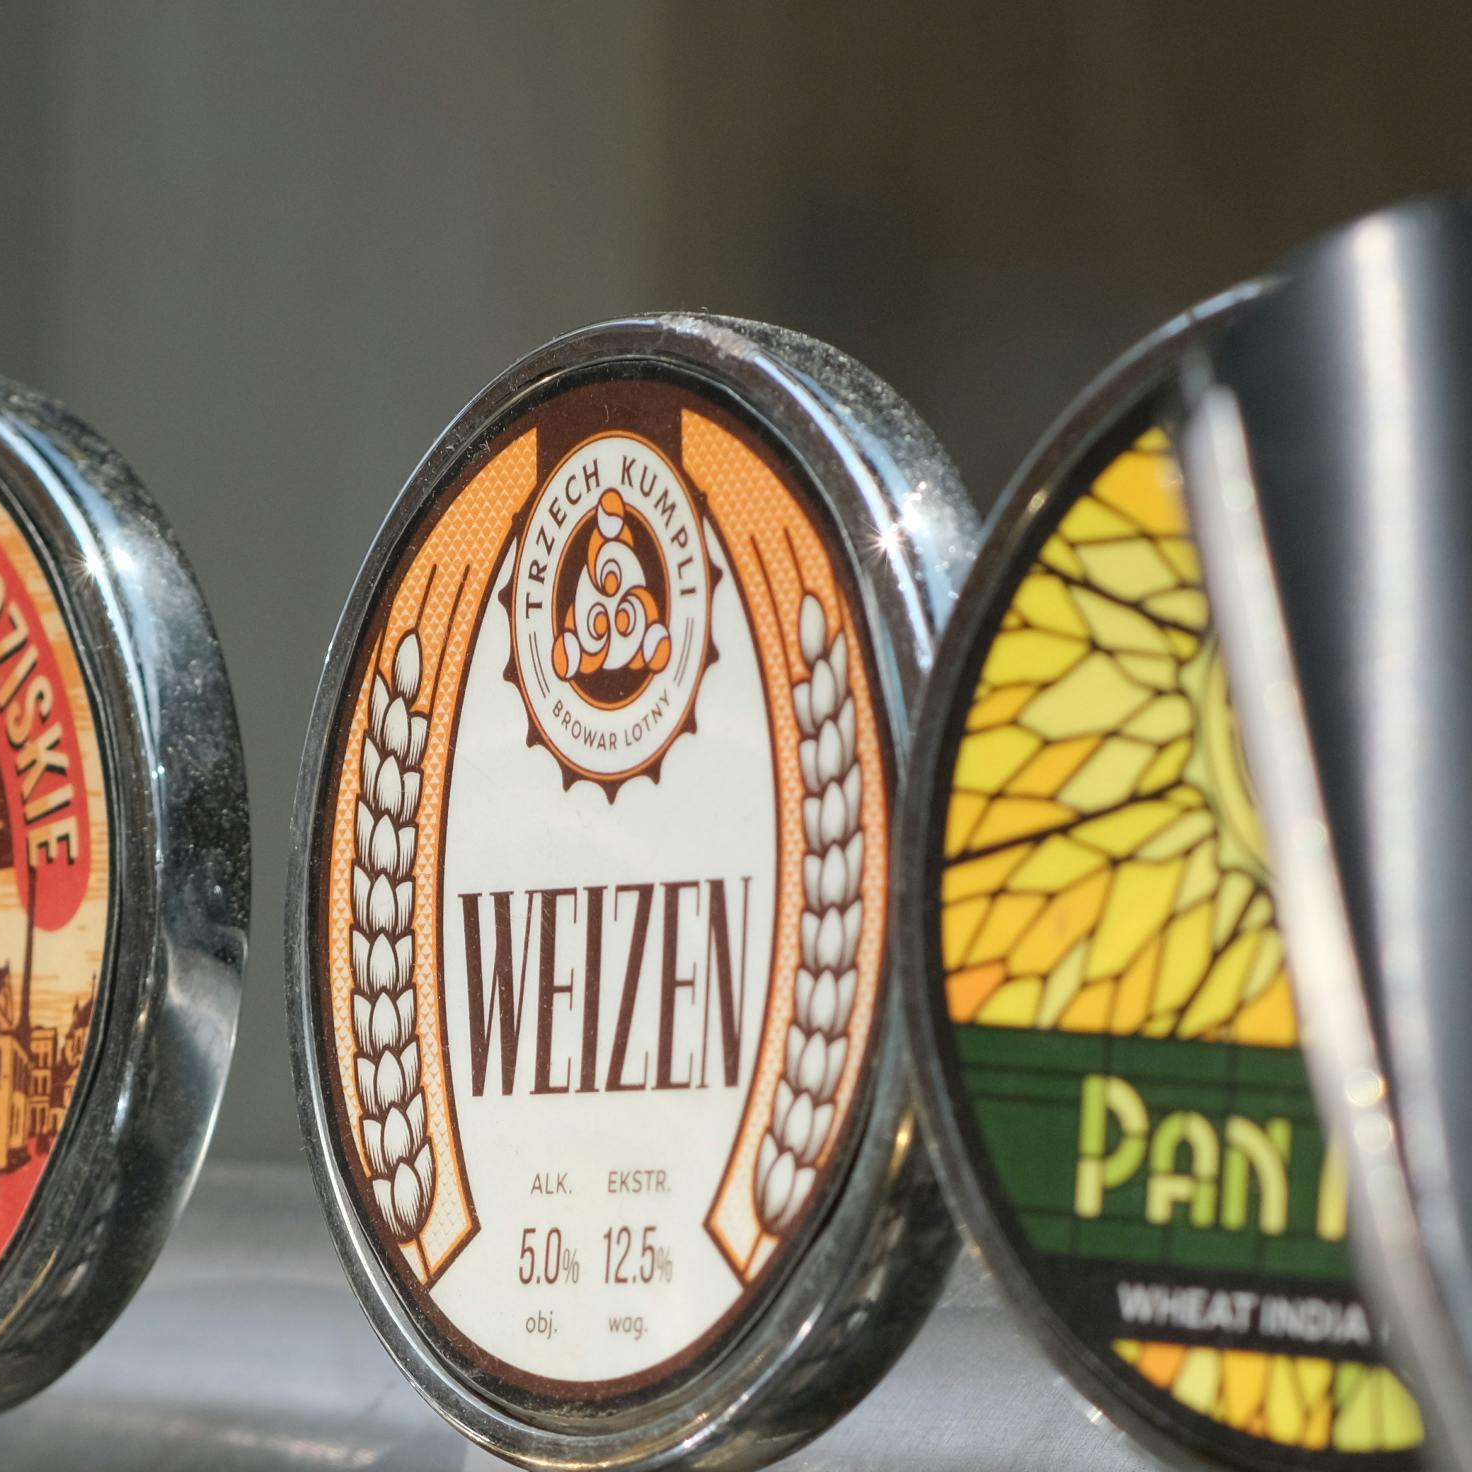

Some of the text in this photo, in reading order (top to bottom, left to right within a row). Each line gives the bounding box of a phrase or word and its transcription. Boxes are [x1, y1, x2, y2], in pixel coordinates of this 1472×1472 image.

[525, 455, 698, 619] TRZECH KUMPLI
[552, 688, 672, 752] BROWAR LOTNY
[457, 875, 754, 1098] WEIZEN
[530, 1169, 673, 1196] ALK. EKSTR.
[518, 1224, 673, 1286] 5.0% 12.5%
[525, 1309, 559, 1341] obj.
[1117, 1281, 1256, 1333] WHEAT
[1259, 1294, 1371, 1344] INDIA
